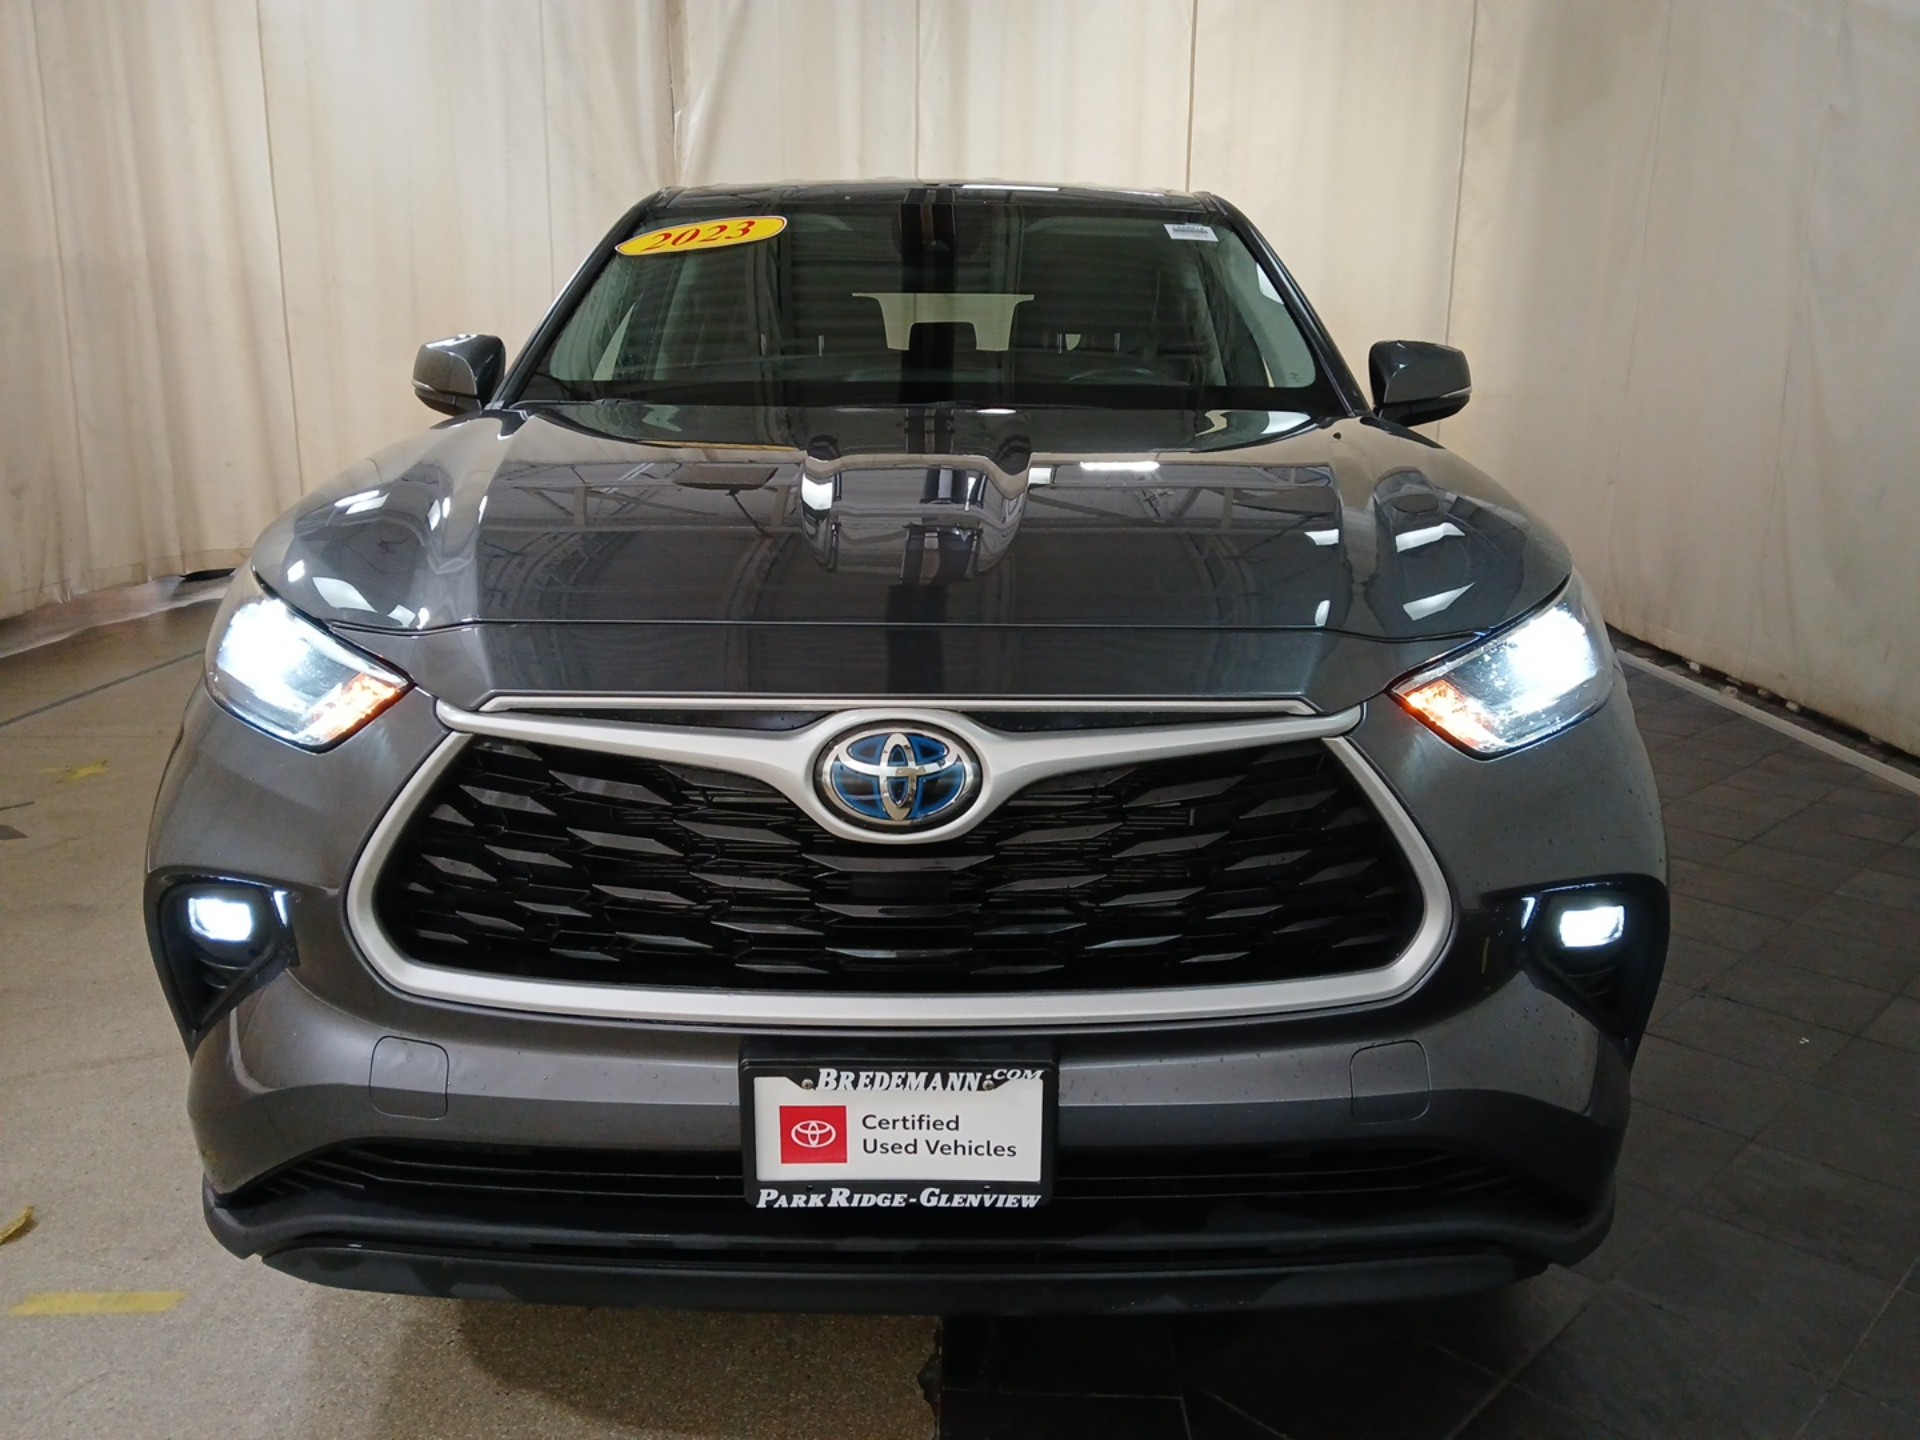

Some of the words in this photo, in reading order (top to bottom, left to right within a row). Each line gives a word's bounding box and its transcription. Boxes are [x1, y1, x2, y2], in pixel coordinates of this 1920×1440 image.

[641, 220, 756, 252] 2023
[861, 1114, 960, 1132] Certified
[862, 1138, 918, 1155] Used
[925, 1140, 1018, 1157] Vehicles
[756, 1188, 826, 1208] PARK
